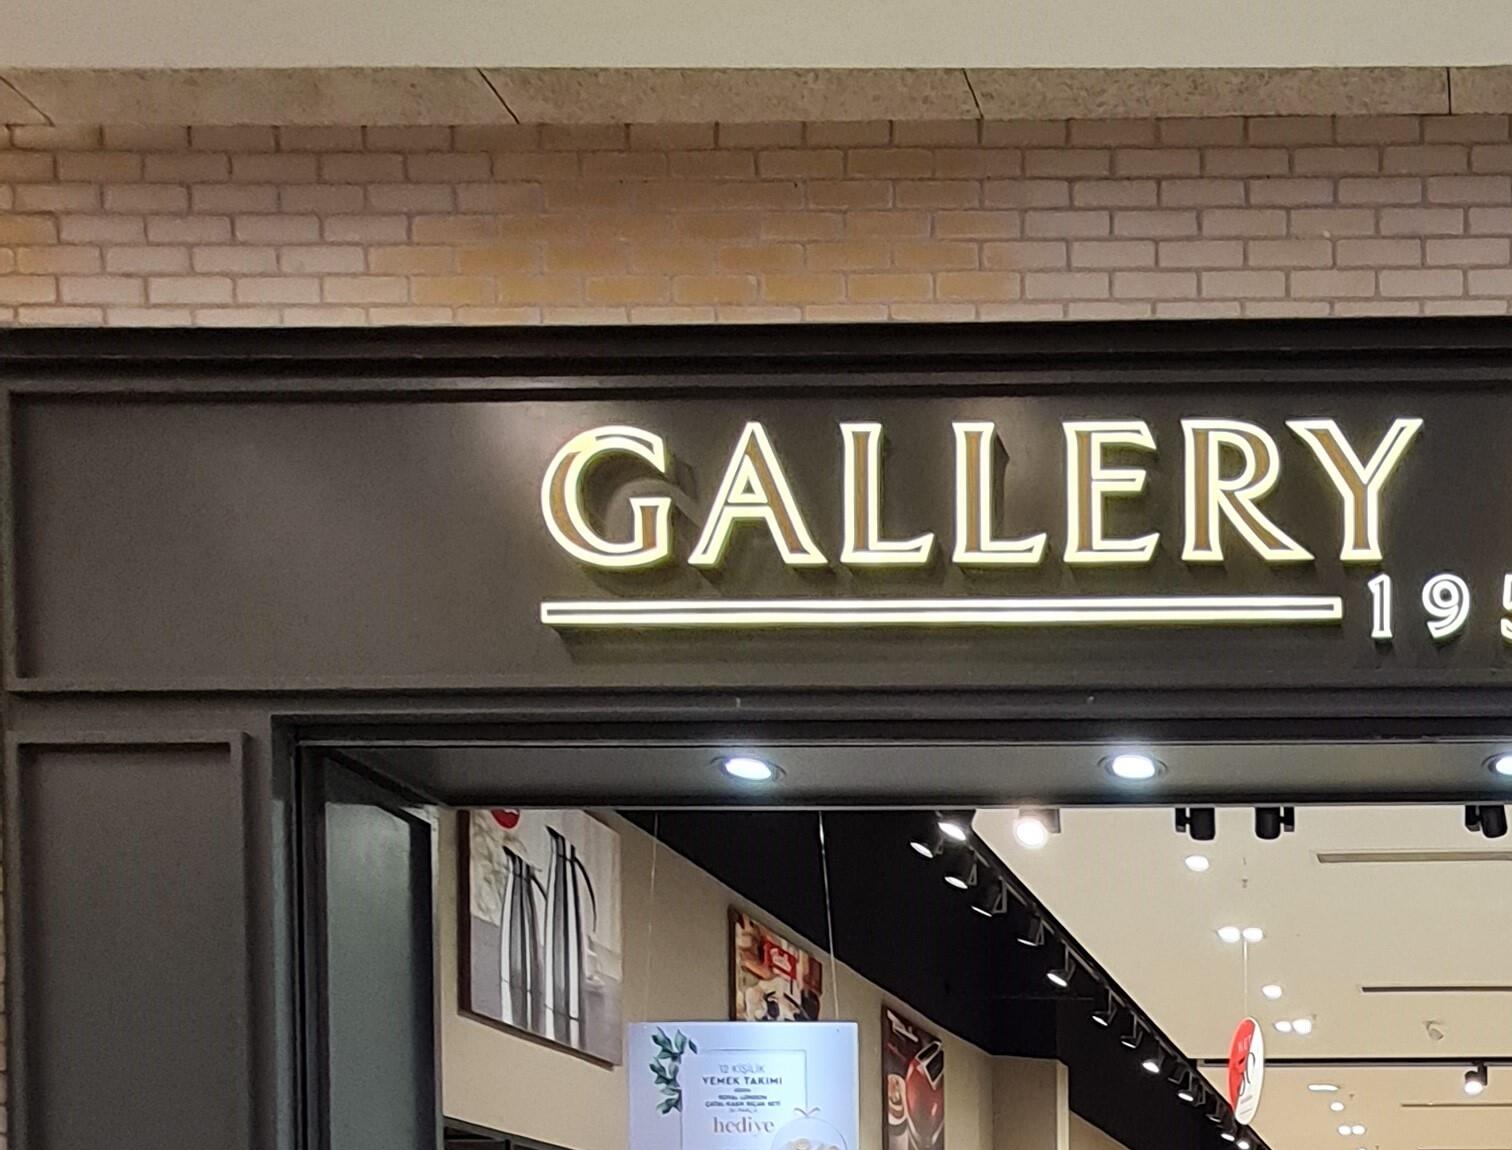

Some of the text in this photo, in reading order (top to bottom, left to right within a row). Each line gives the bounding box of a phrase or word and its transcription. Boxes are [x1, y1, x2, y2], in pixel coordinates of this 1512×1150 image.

[540, 416, 1424, 567] GALLERY
[702, 1076, 740, 1085] YEMEK
[713, 1116, 775, 1136] hediye
